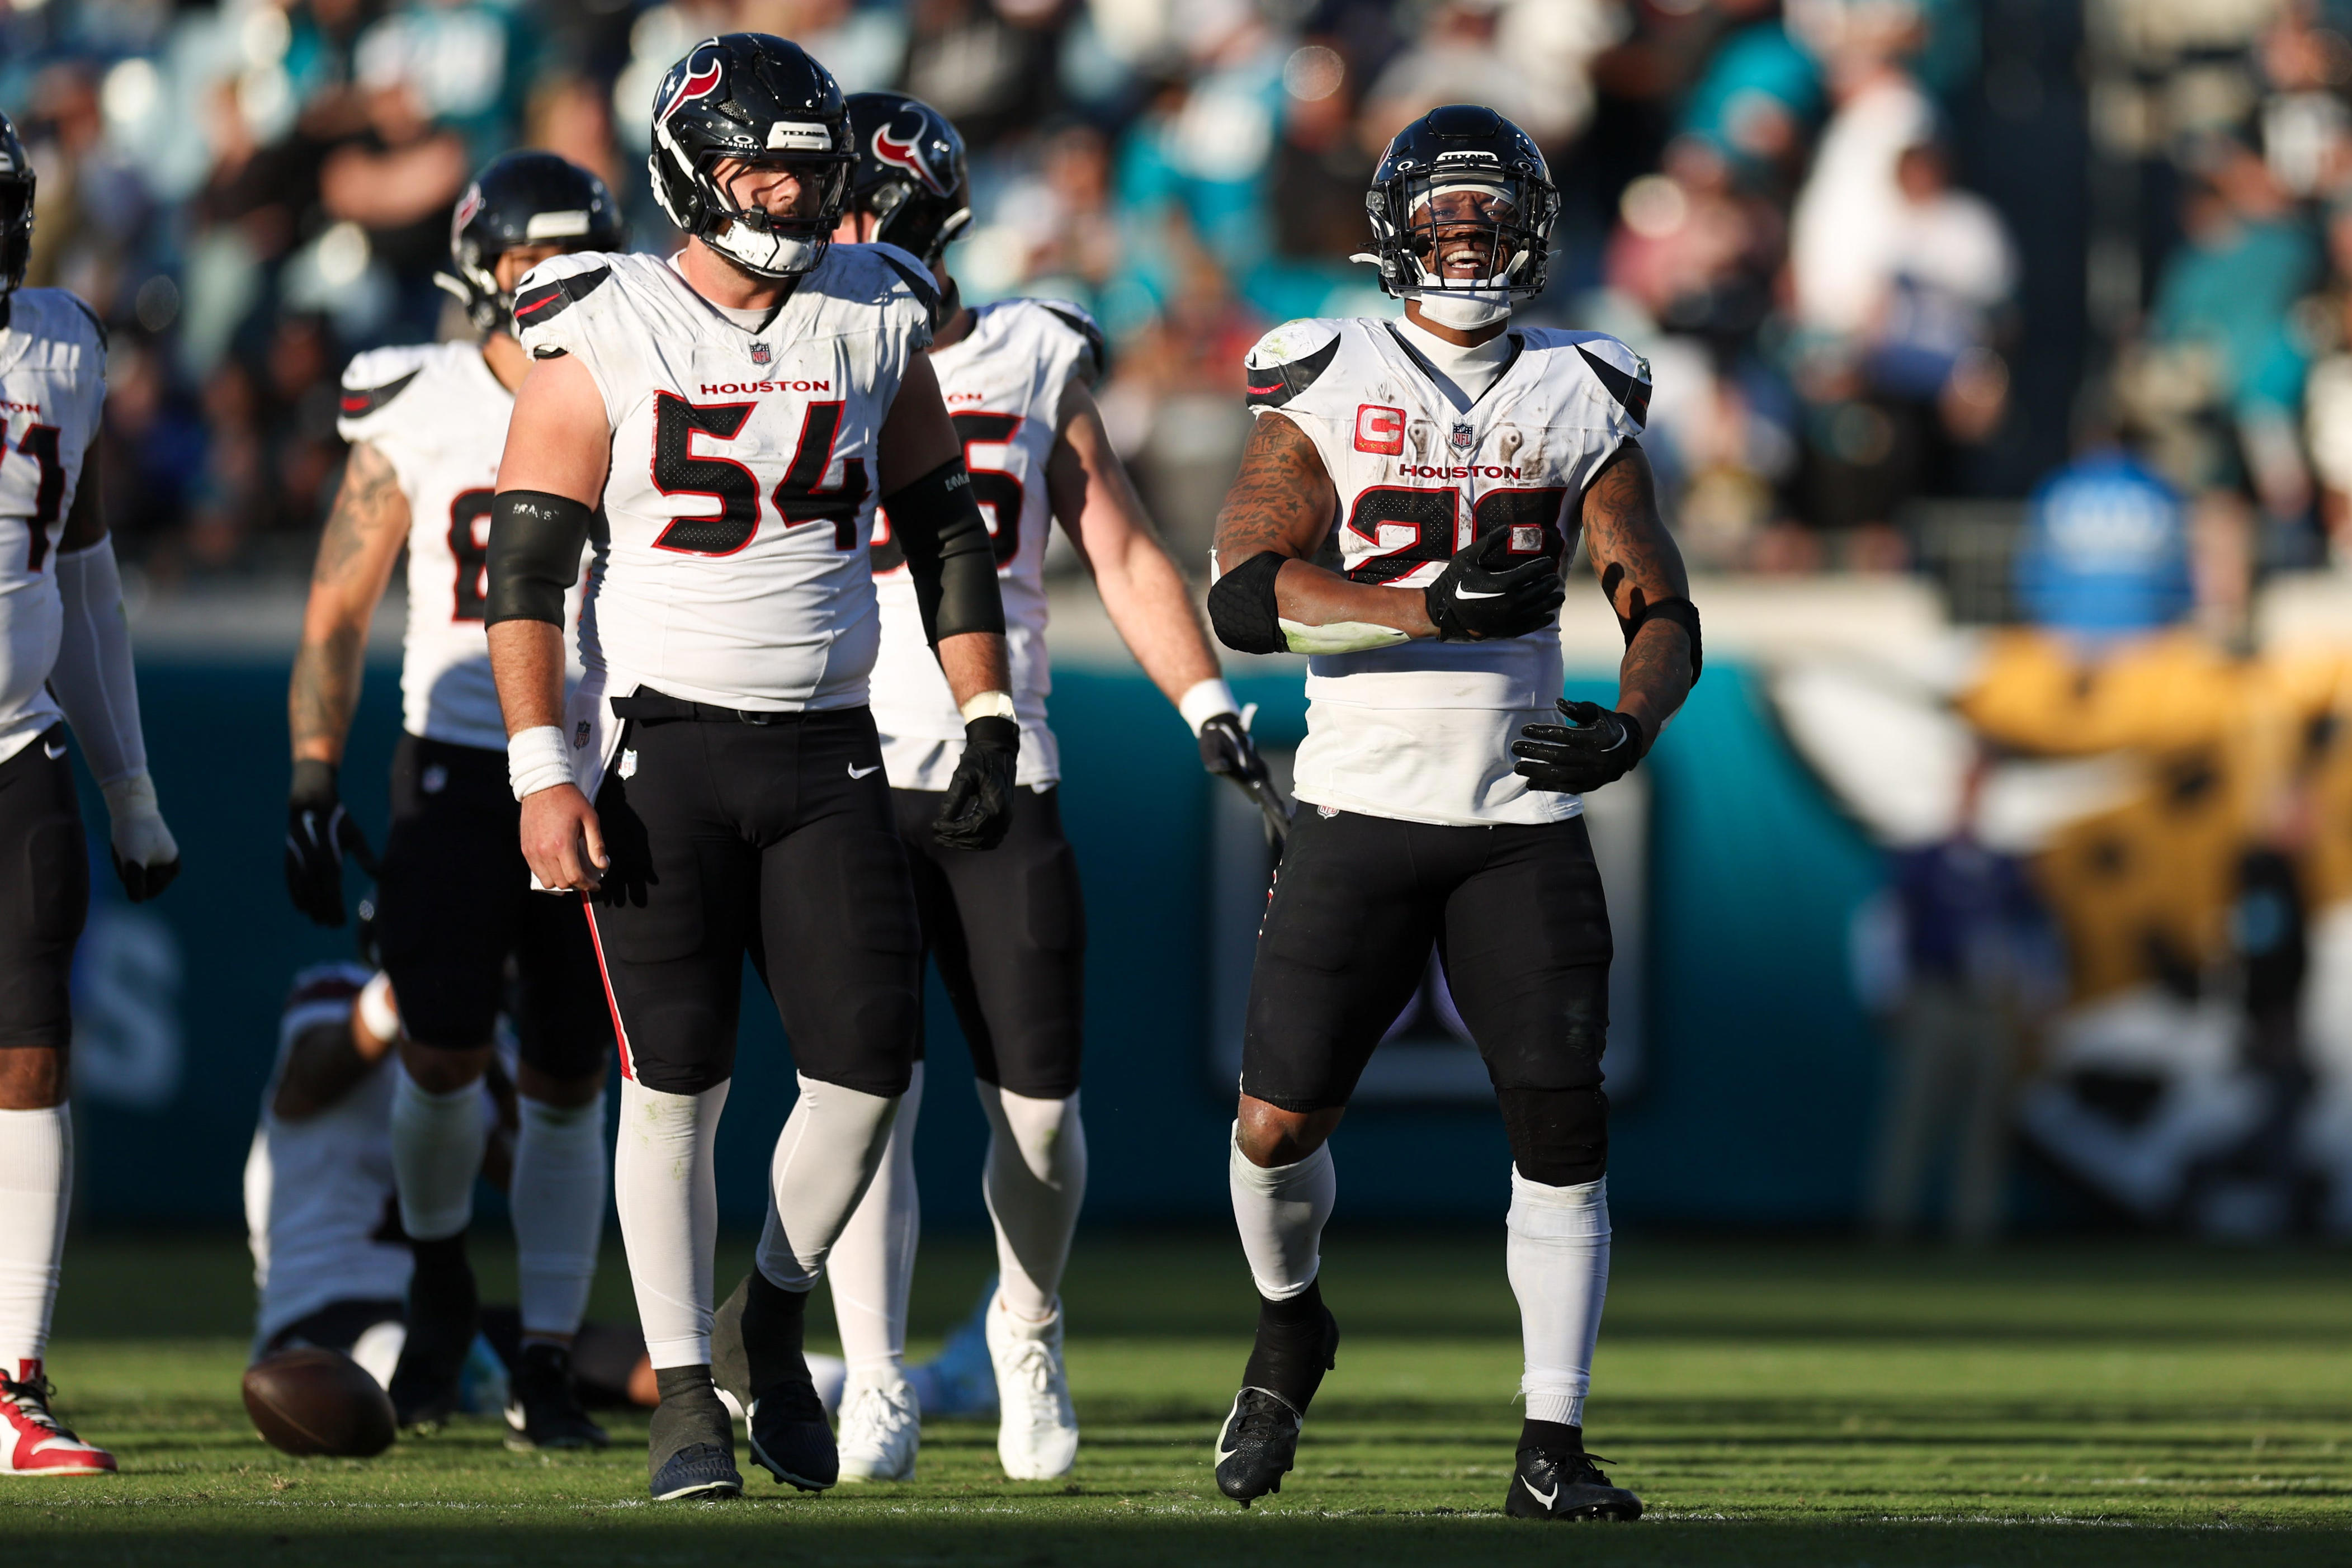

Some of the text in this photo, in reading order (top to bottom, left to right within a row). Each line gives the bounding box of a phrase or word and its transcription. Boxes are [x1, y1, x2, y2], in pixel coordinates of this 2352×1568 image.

[728, 141, 759, 150] OAKLEY
[753, 351, 770, 362] NFL
[700, 380, 830, 395] HOUSTON
[1359, 408, 1401, 442] C
[1454, 433, 1471, 445] NFL
[650, 389, 872, 558] 54
[1399, 464, 1521, 479] HOUSTON
[0, 418, 66, 573] 1
